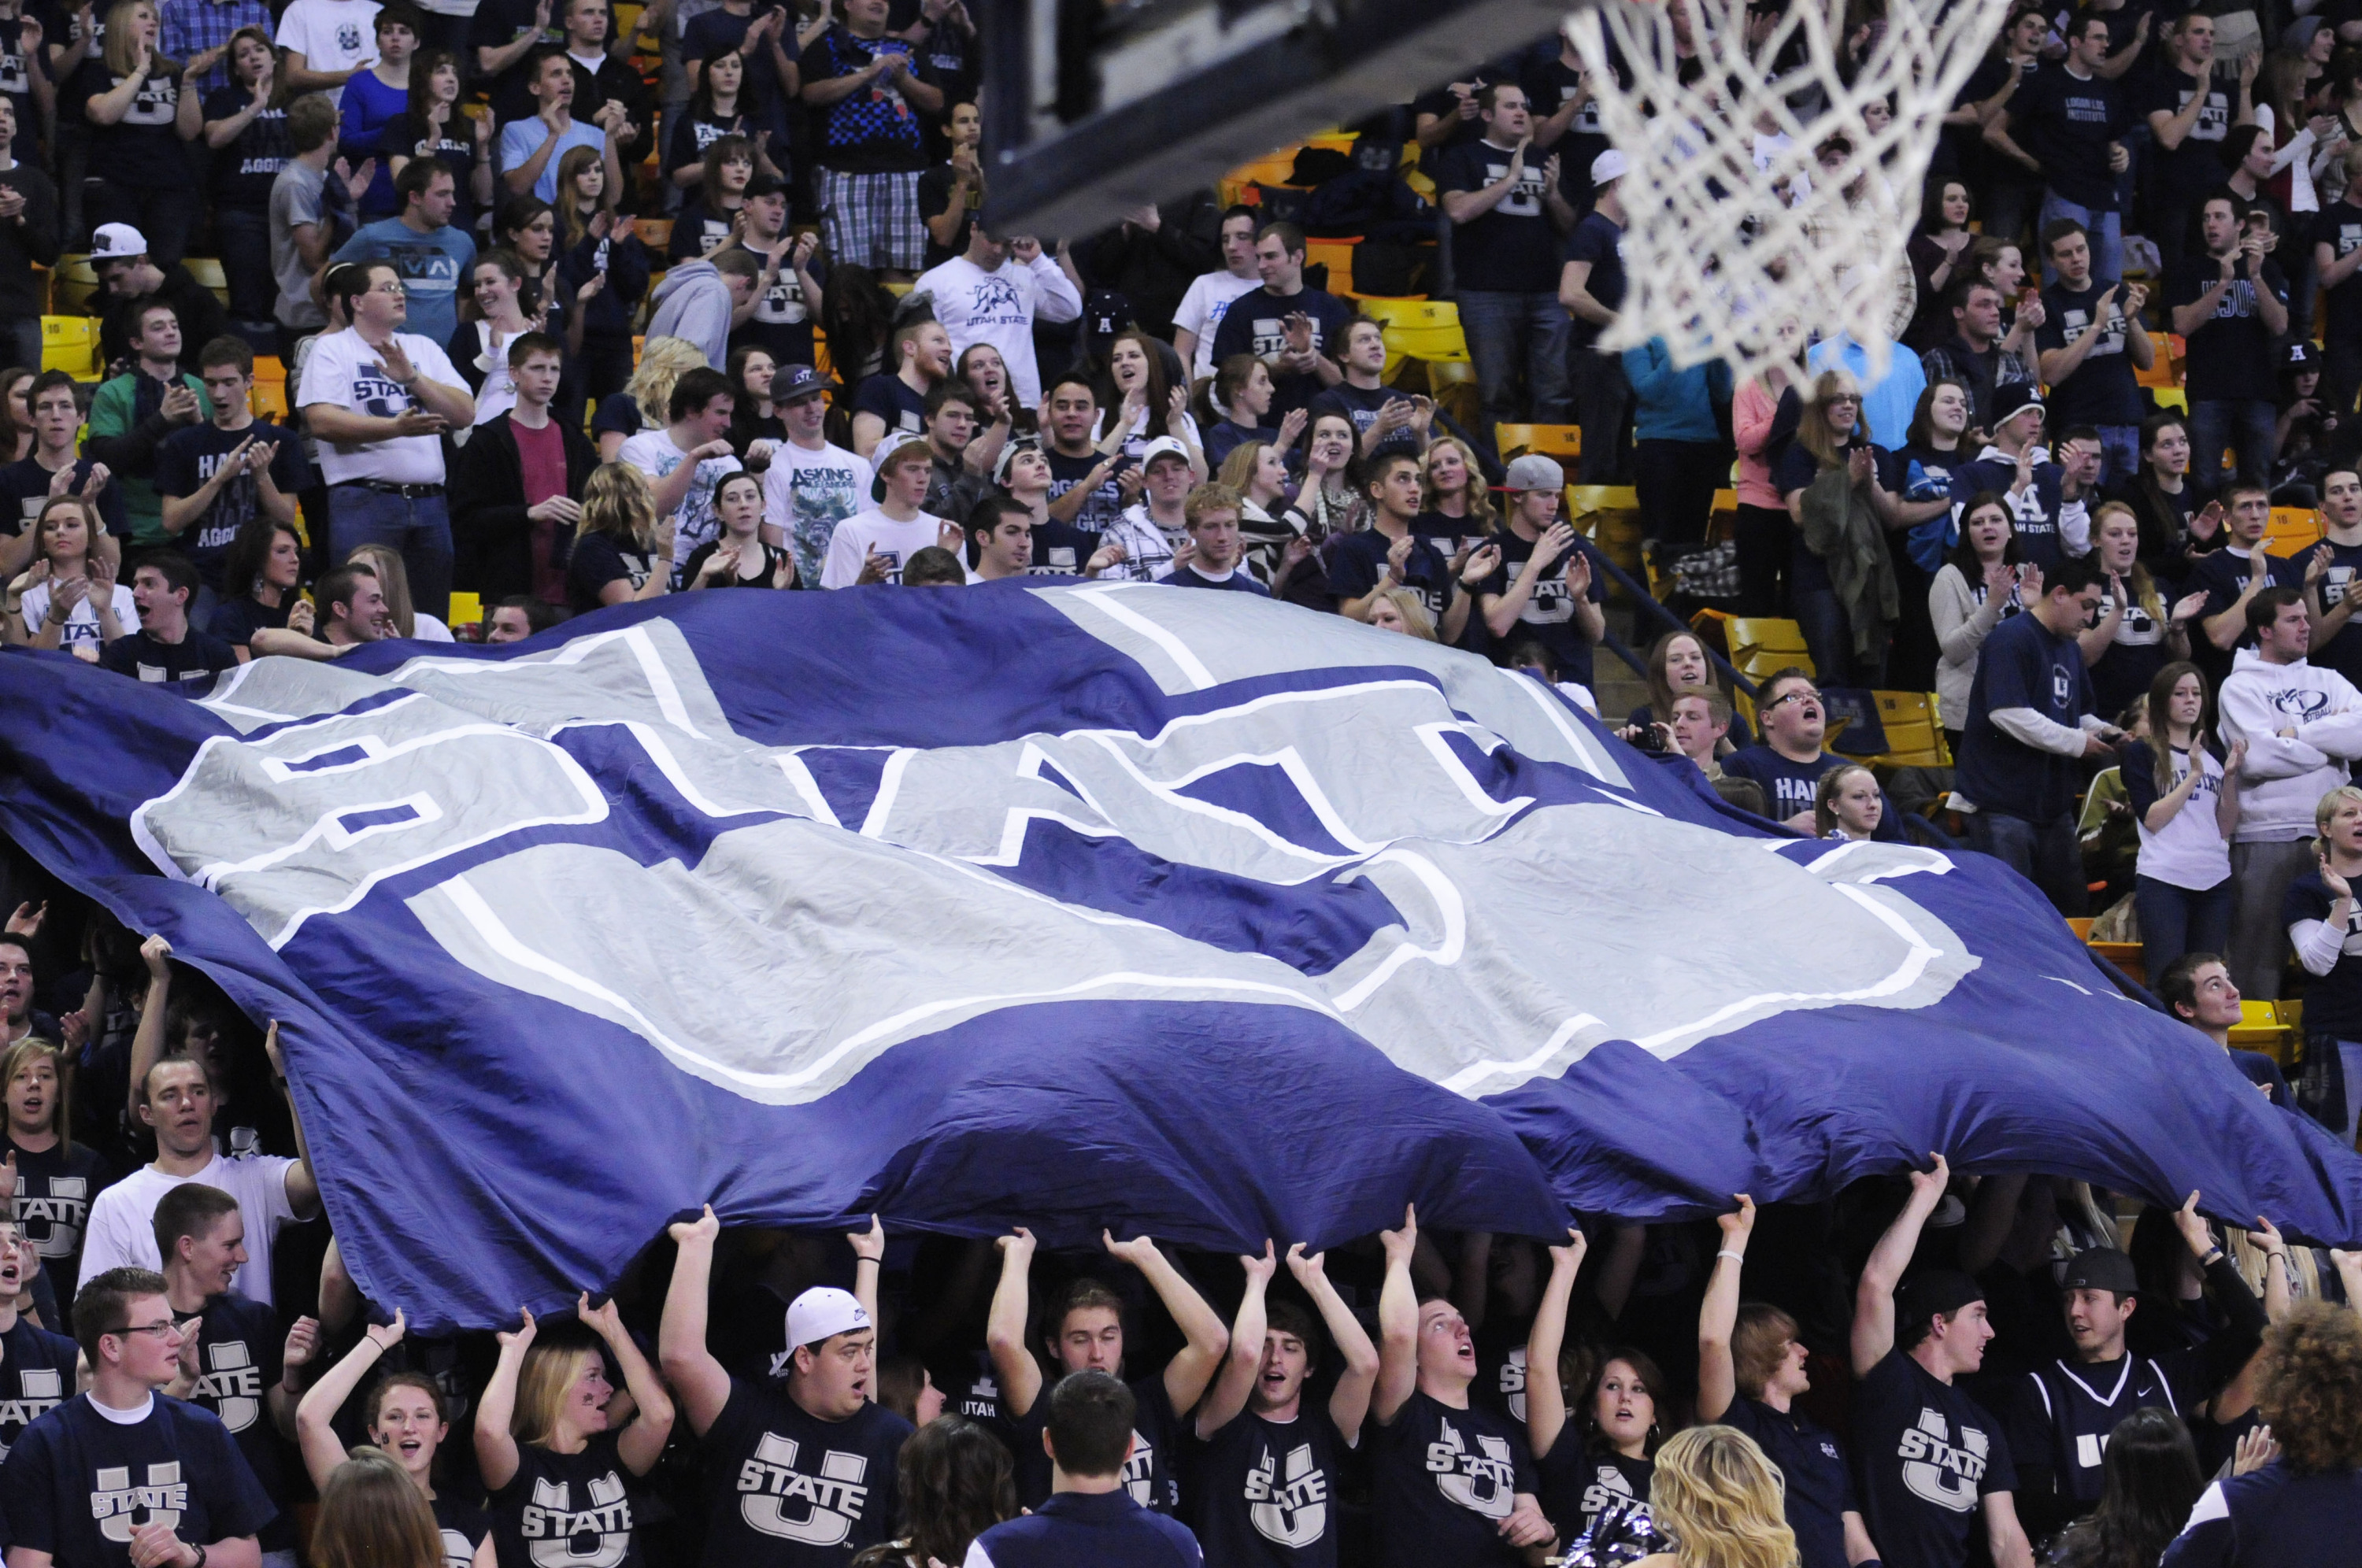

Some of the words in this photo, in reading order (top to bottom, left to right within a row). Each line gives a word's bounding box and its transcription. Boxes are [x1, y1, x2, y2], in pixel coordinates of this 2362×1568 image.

[966, 316, 995, 327] UTAH
[1000, 316, 1029, 326] STATE
[1253, 335, 1324, 357] STE
[790, 468, 854, 488] ASKING
[2027, 523, 2056, 534] STATE
[1776, 777, 1819, 802] HAI
[12, 1196, 88, 1227] TATE
[961, 1400, 996, 1418] UTAH
[1897, 1426, 1987, 1482] STATE
[91, 1482, 187, 1519] STATE
[737, 1459, 868, 1521] STATE
[522, 1499, 634, 1538] STATE
[1579, 1485, 1655, 1529] STA
[843, 1540, 854, 1550] TM
